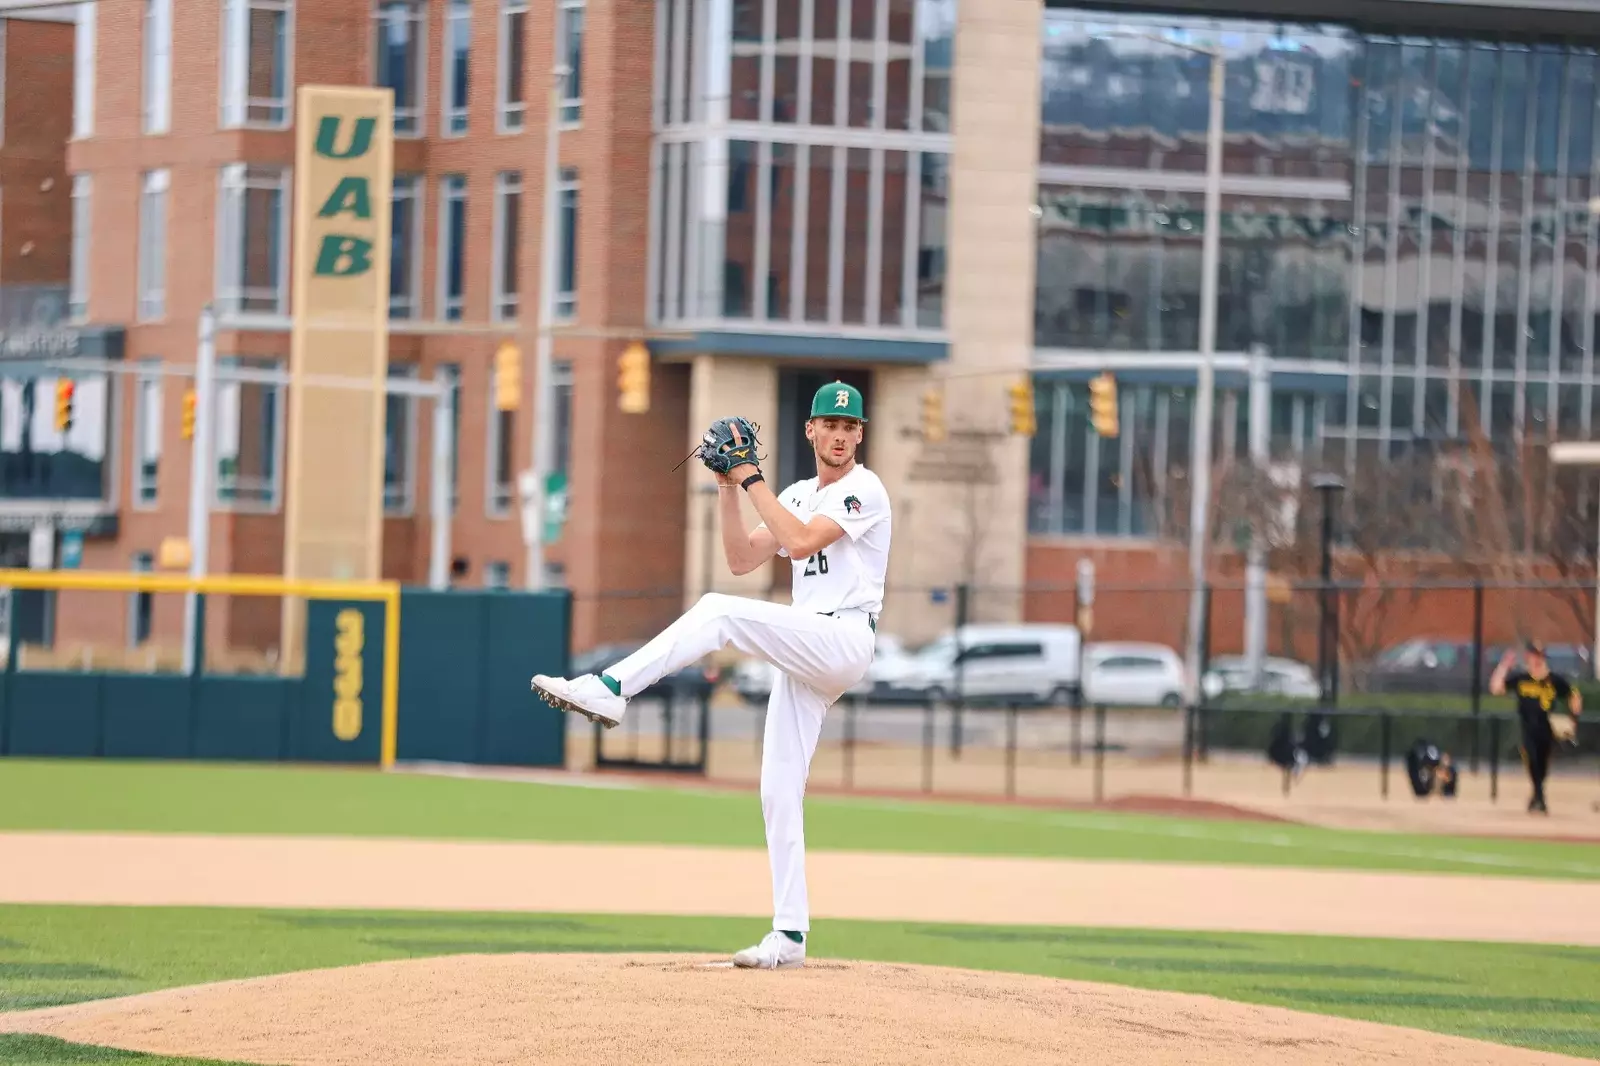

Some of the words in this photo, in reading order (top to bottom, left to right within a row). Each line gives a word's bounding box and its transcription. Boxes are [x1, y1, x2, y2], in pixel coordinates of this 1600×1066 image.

[313, 116, 377, 278] UAB
[834, 389, 850, 409] B
[803, 549, 829, 577] 26
[332, 609, 365, 742] 330
